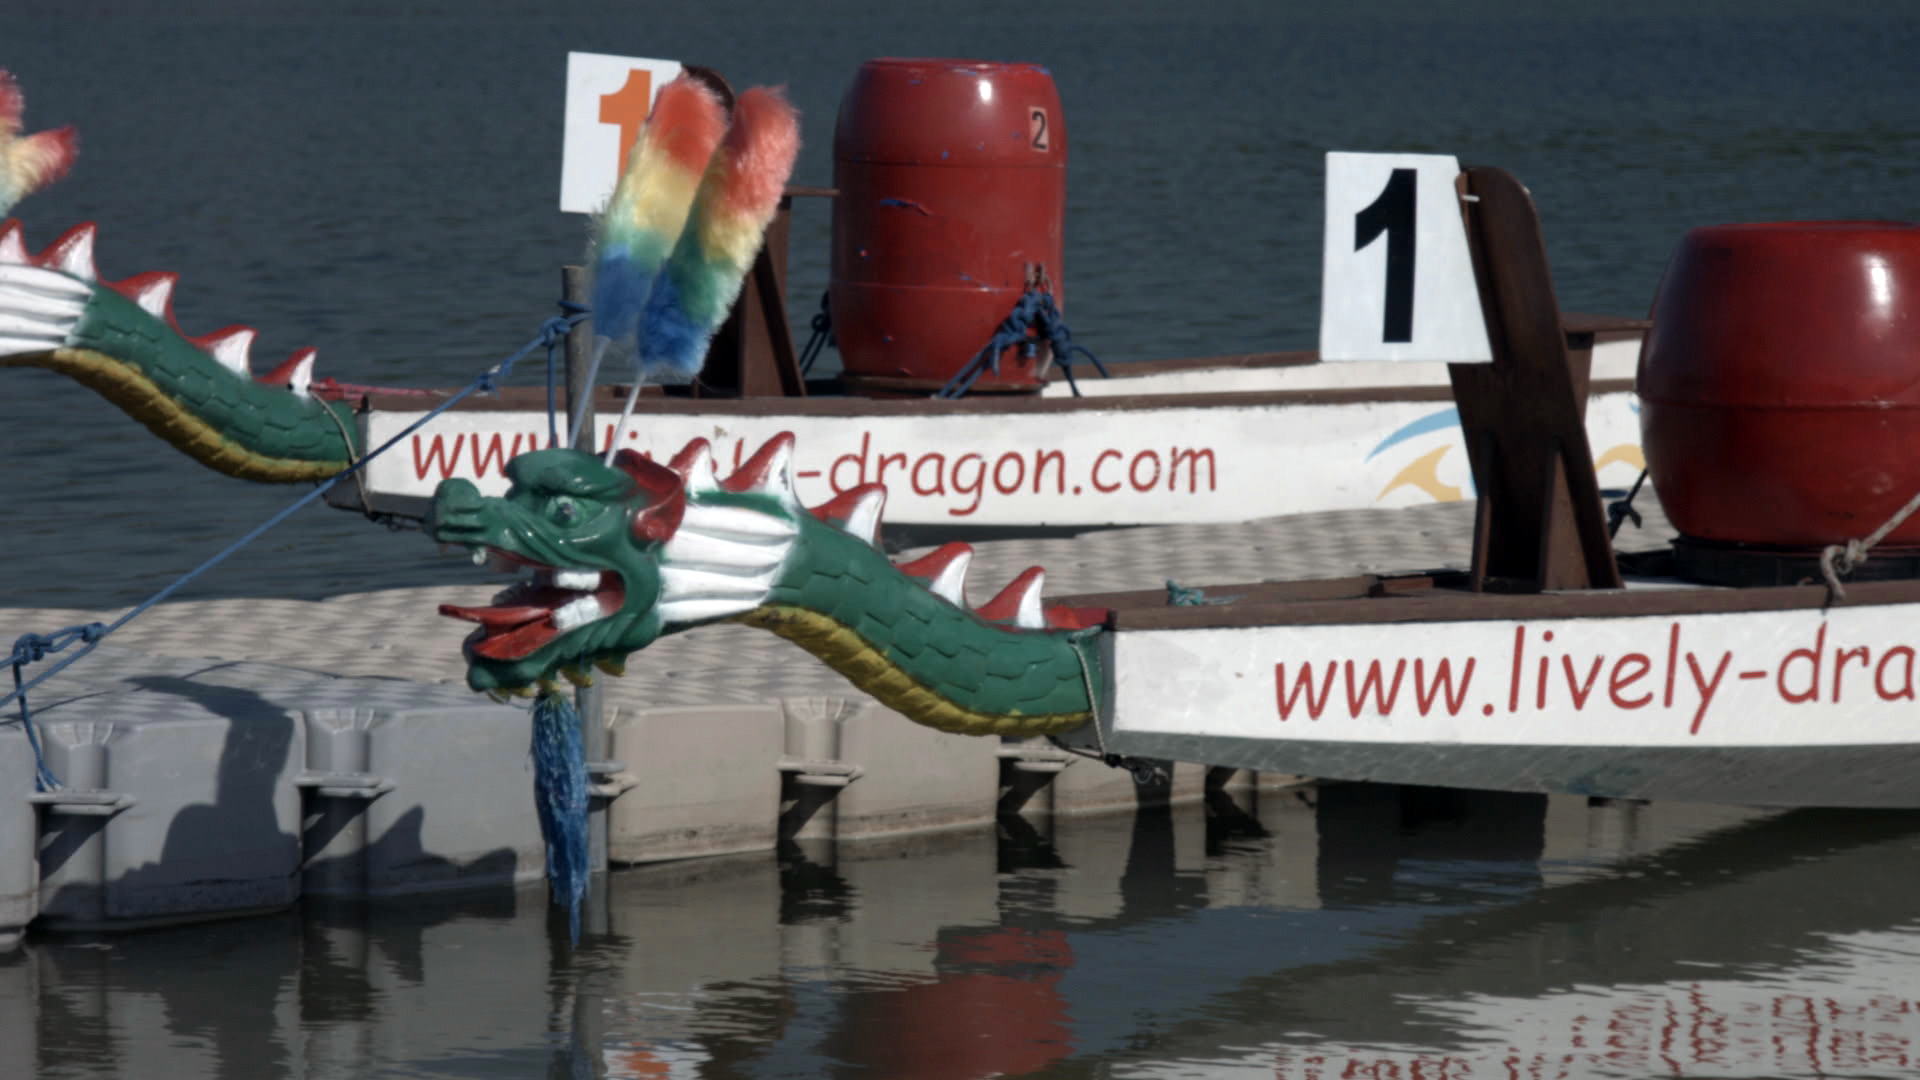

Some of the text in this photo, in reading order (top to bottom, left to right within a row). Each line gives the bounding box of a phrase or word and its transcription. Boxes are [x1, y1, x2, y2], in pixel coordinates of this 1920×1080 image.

[599, 68, 652, 182] 1
[1031, 110, 1047, 150] 2
[1354, 168, 1417, 343] 1
[1275, 620, 1916, 736] www.lively-dra
